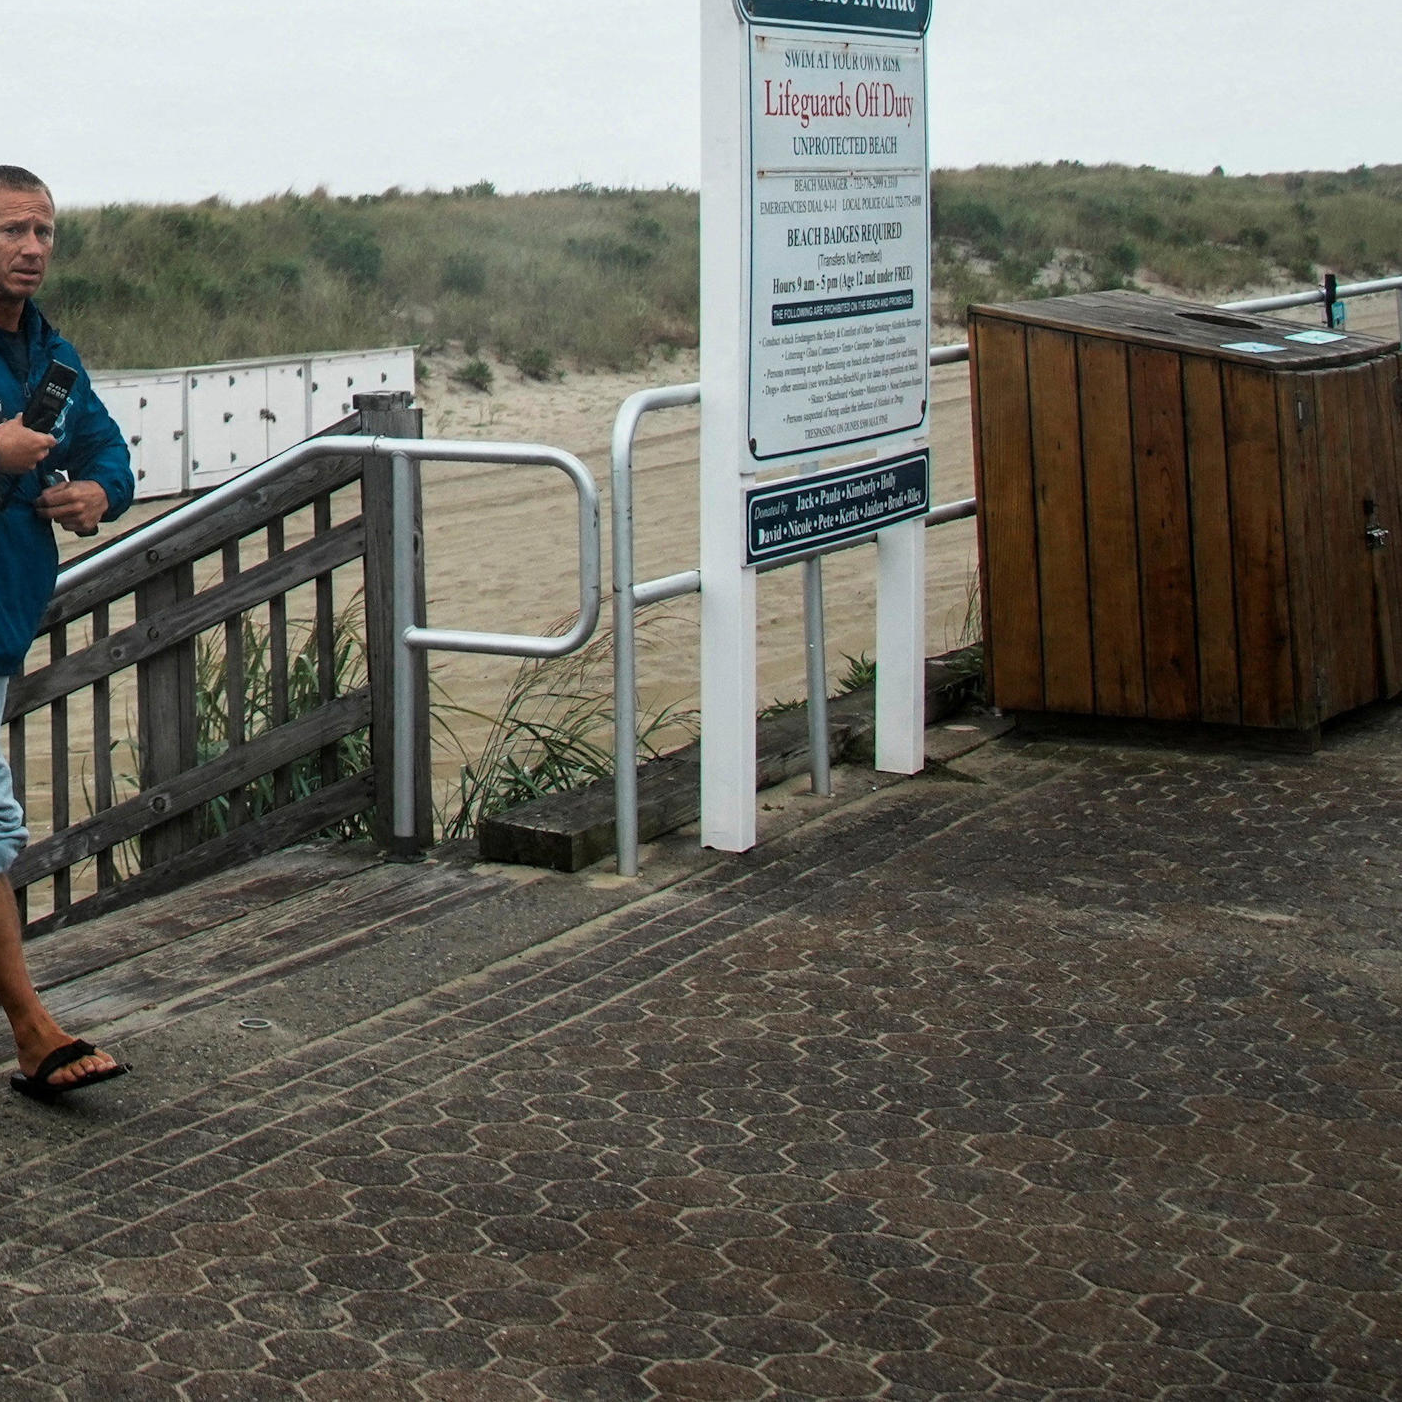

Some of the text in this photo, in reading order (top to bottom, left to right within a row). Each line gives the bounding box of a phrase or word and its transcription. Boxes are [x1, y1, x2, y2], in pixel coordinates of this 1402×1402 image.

[785, 50, 901, 72] SWIM AT YOUR OWN RISK
[764, 79, 913, 129] Lifeguards Off Duty
[793, 136, 897, 155] UNPROTECTED BEACH
[795, 178, 816, 191] BEACH
[818, 177, 848, 191] MANAGER
[760, 200, 806, 215] EMERGENCIES
[807, 199, 822, 213] DIAL
[842, 198, 861, 211] LOCAL
[862, 196, 880, 210] POLICE
[881, 196, 894, 209] CALL
[787, 222, 902, 247] BEACH BADGES REQUIRED
[818, 249, 882, 270] (Transfers Not Permitted)
[773, 278, 796, 294] Hours
[797, 276, 802, 293] 9
[804, 279, 814, 291] am
[827, 277, 838, 294] pm
[839, 272, 854, 292] (Age
[856, 270, 863, 286] 12
[865, 269, 876, 285] and
[877, 268, 894, 283] under
[894, 265, 913, 282] FREE)
[773, 309, 783, 319] THE
[784, 306, 813, 318] FOLLOWING
[813, 305, 823, 315] ARE
[796, 471, 896, 512] Jack Paula Kimberly Holly
[754, 502, 789, 520] Donated by
[758, 524, 782, 546] David
[788, 518, 812, 538] Nicole
[818, 513, 834, 531] Pete
[839, 507, 860, 525] Kerik
[863, 500, 884, 518] Jaiden
[907, 488, 922, 505] Riley
